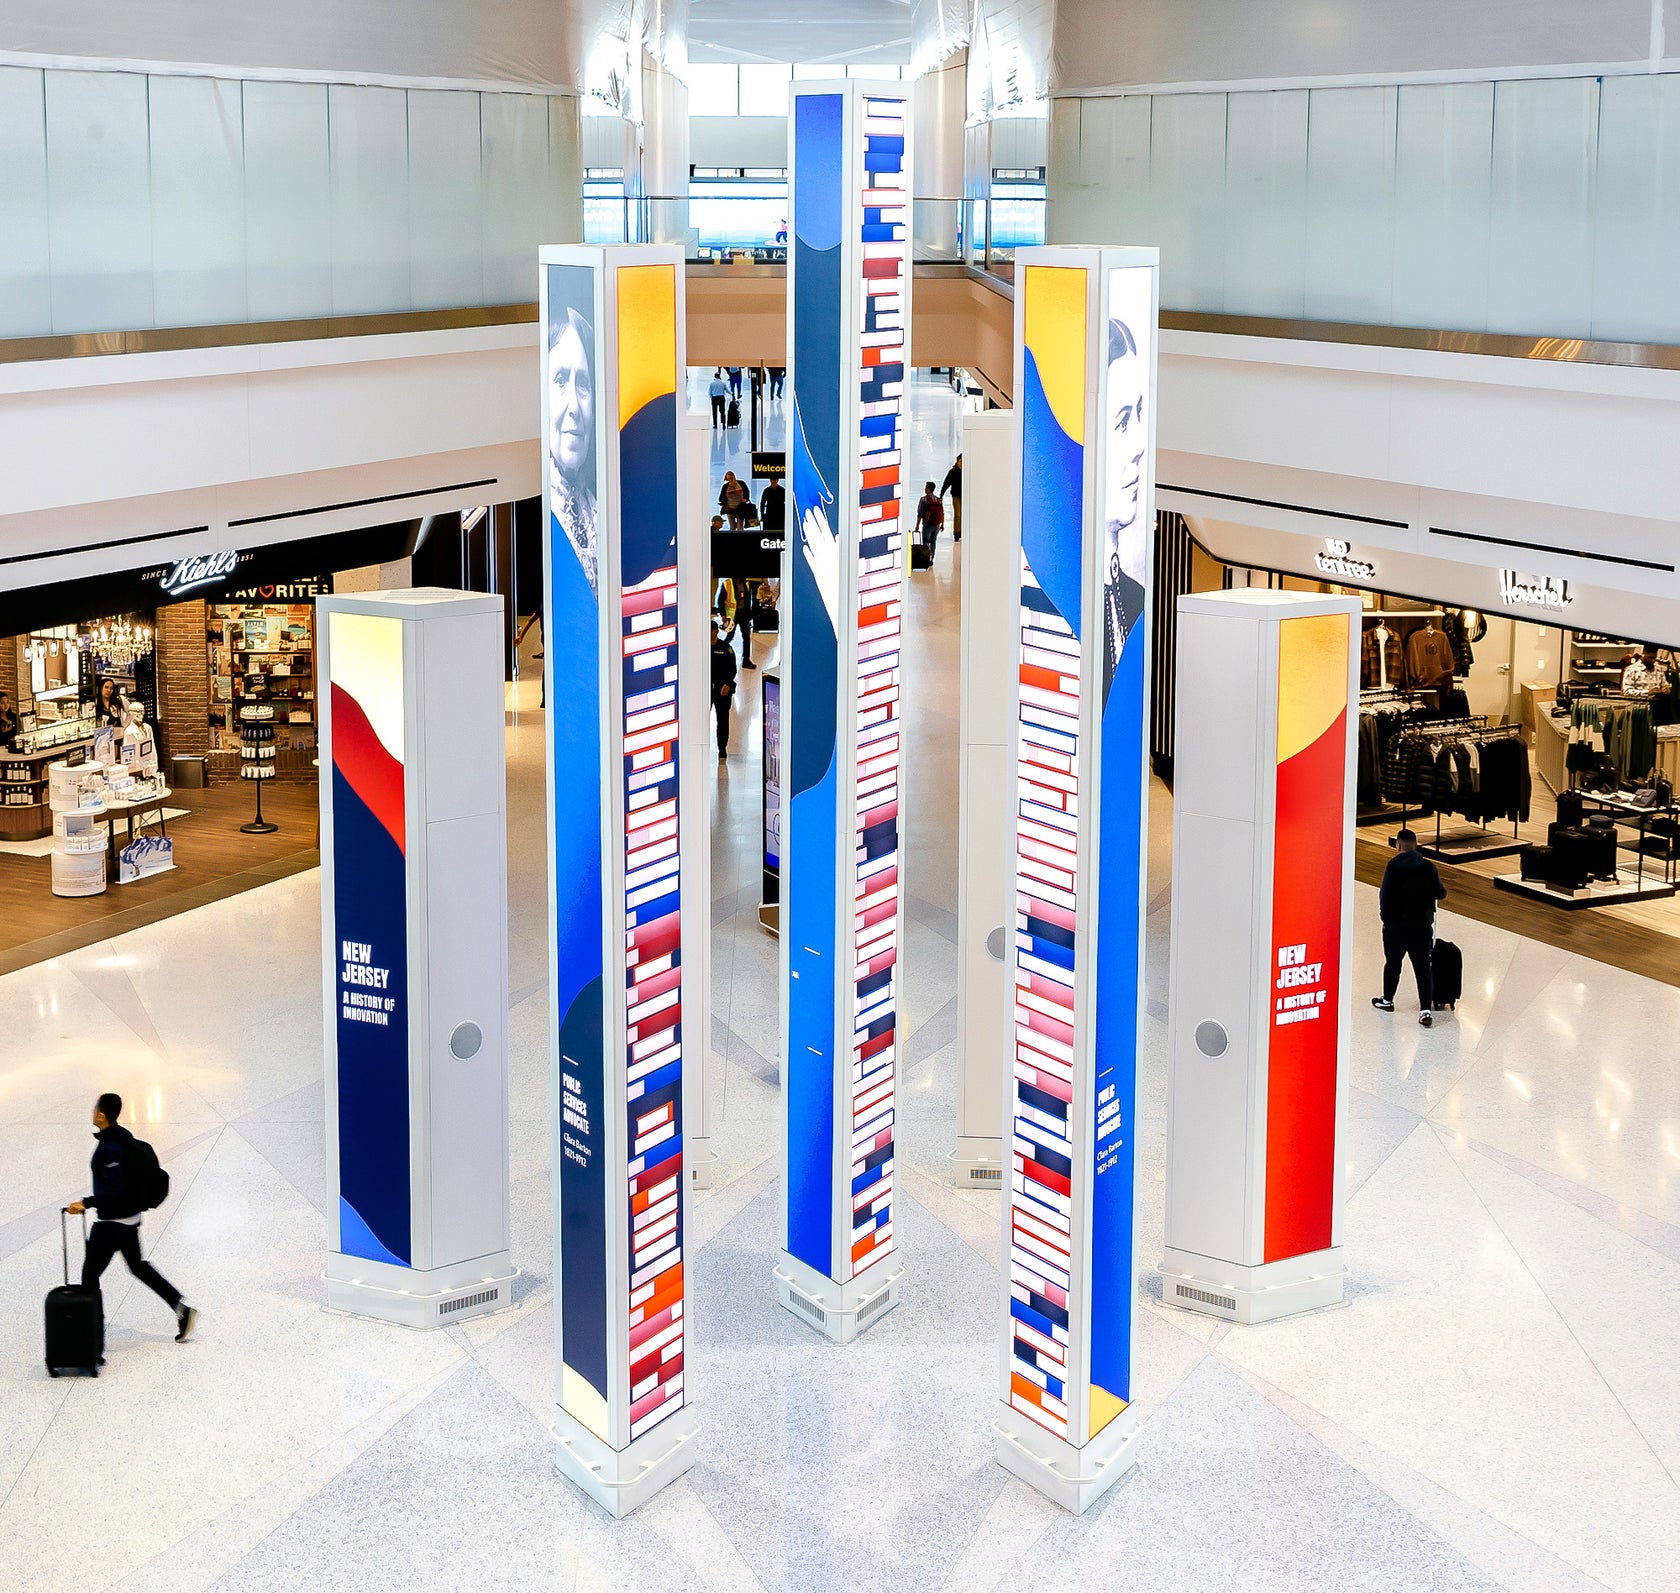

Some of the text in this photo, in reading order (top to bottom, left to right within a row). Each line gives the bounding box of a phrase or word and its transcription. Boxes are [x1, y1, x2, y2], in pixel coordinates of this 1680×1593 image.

[141, 569, 167, 581] SINCE
[160, 549, 237, 589] Kiehl's
[1314, 553, 1375, 581] tentree
[1499, 567, 1572, 608] Herschel
[342, 940, 372, 964] NEW
[1278, 943, 1307, 968] NEW
[342, 962, 389, 989] JERSEY
[1276, 962, 1323, 989] JERSEY
[343, 990, 395, 1012] A HISTORY OF
[1276, 989, 1327, 1011] A HISTORY OF
[343, 1005, 388, 1026] INNOVATION
[562, 1072, 582, 1095] PUBLIC
[563, 1132, 592, 1157] Clara Barton
